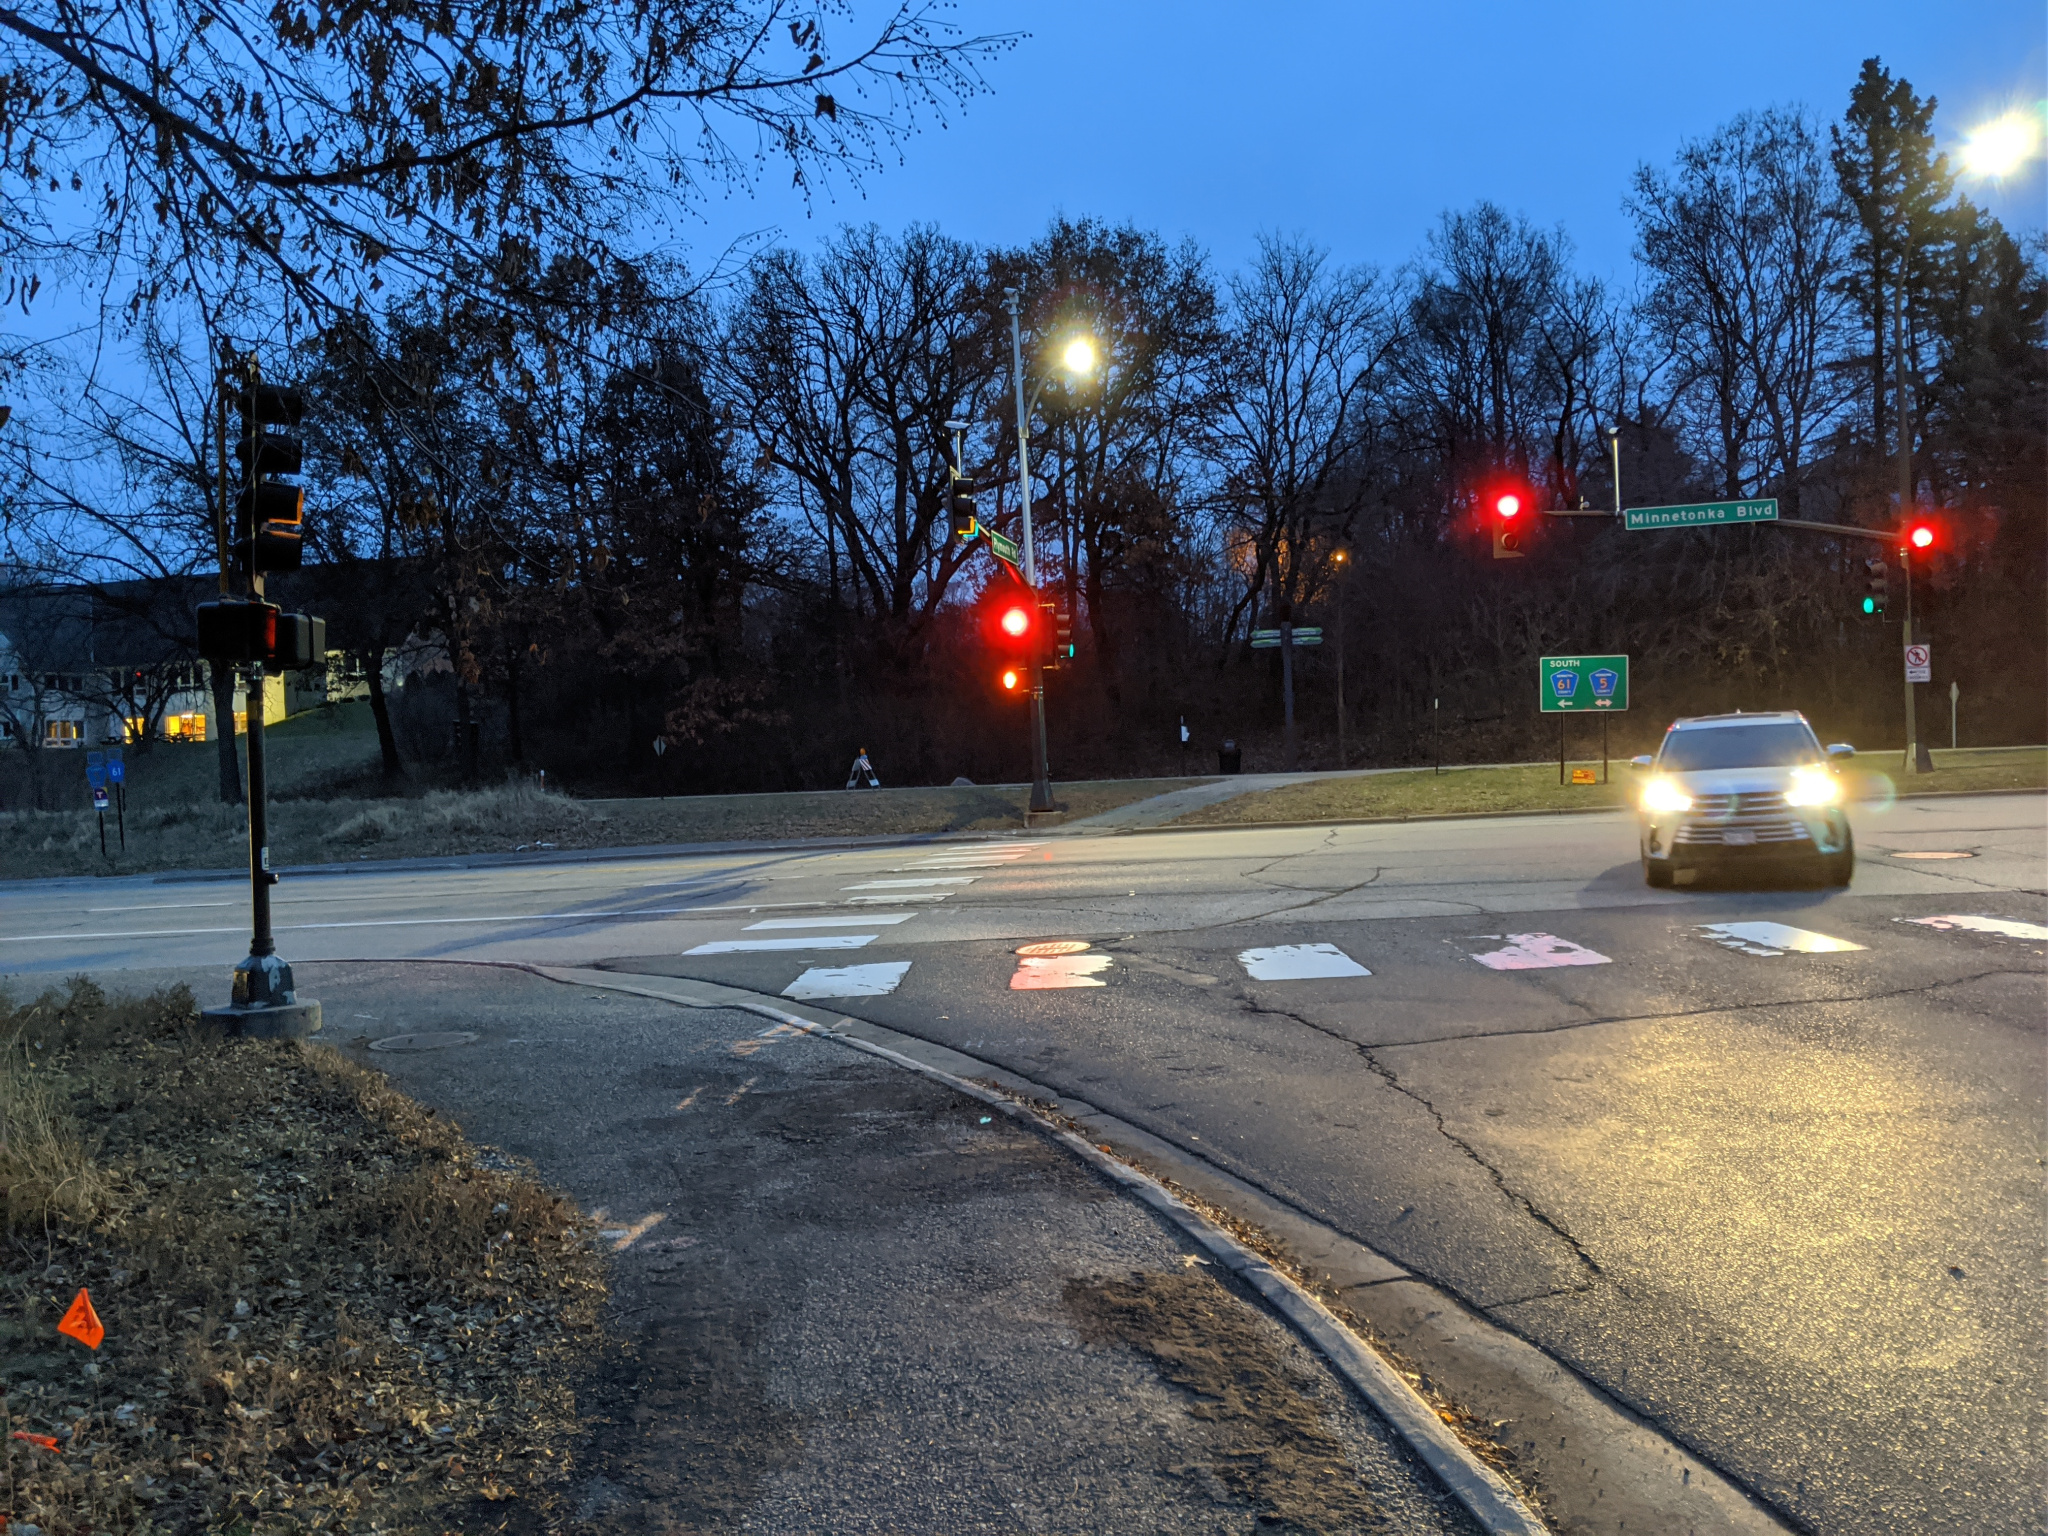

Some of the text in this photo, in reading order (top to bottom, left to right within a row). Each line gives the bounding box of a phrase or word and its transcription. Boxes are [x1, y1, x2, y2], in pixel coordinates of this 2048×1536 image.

[1631, 504, 1773, 525] Minnetonka Blvd
[1549, 660, 1580, 668] SOUTH
[1557, 678, 1571, 690] 61
[1599, 677, 1608, 689] 5
[112, 767, 121, 776] 61
